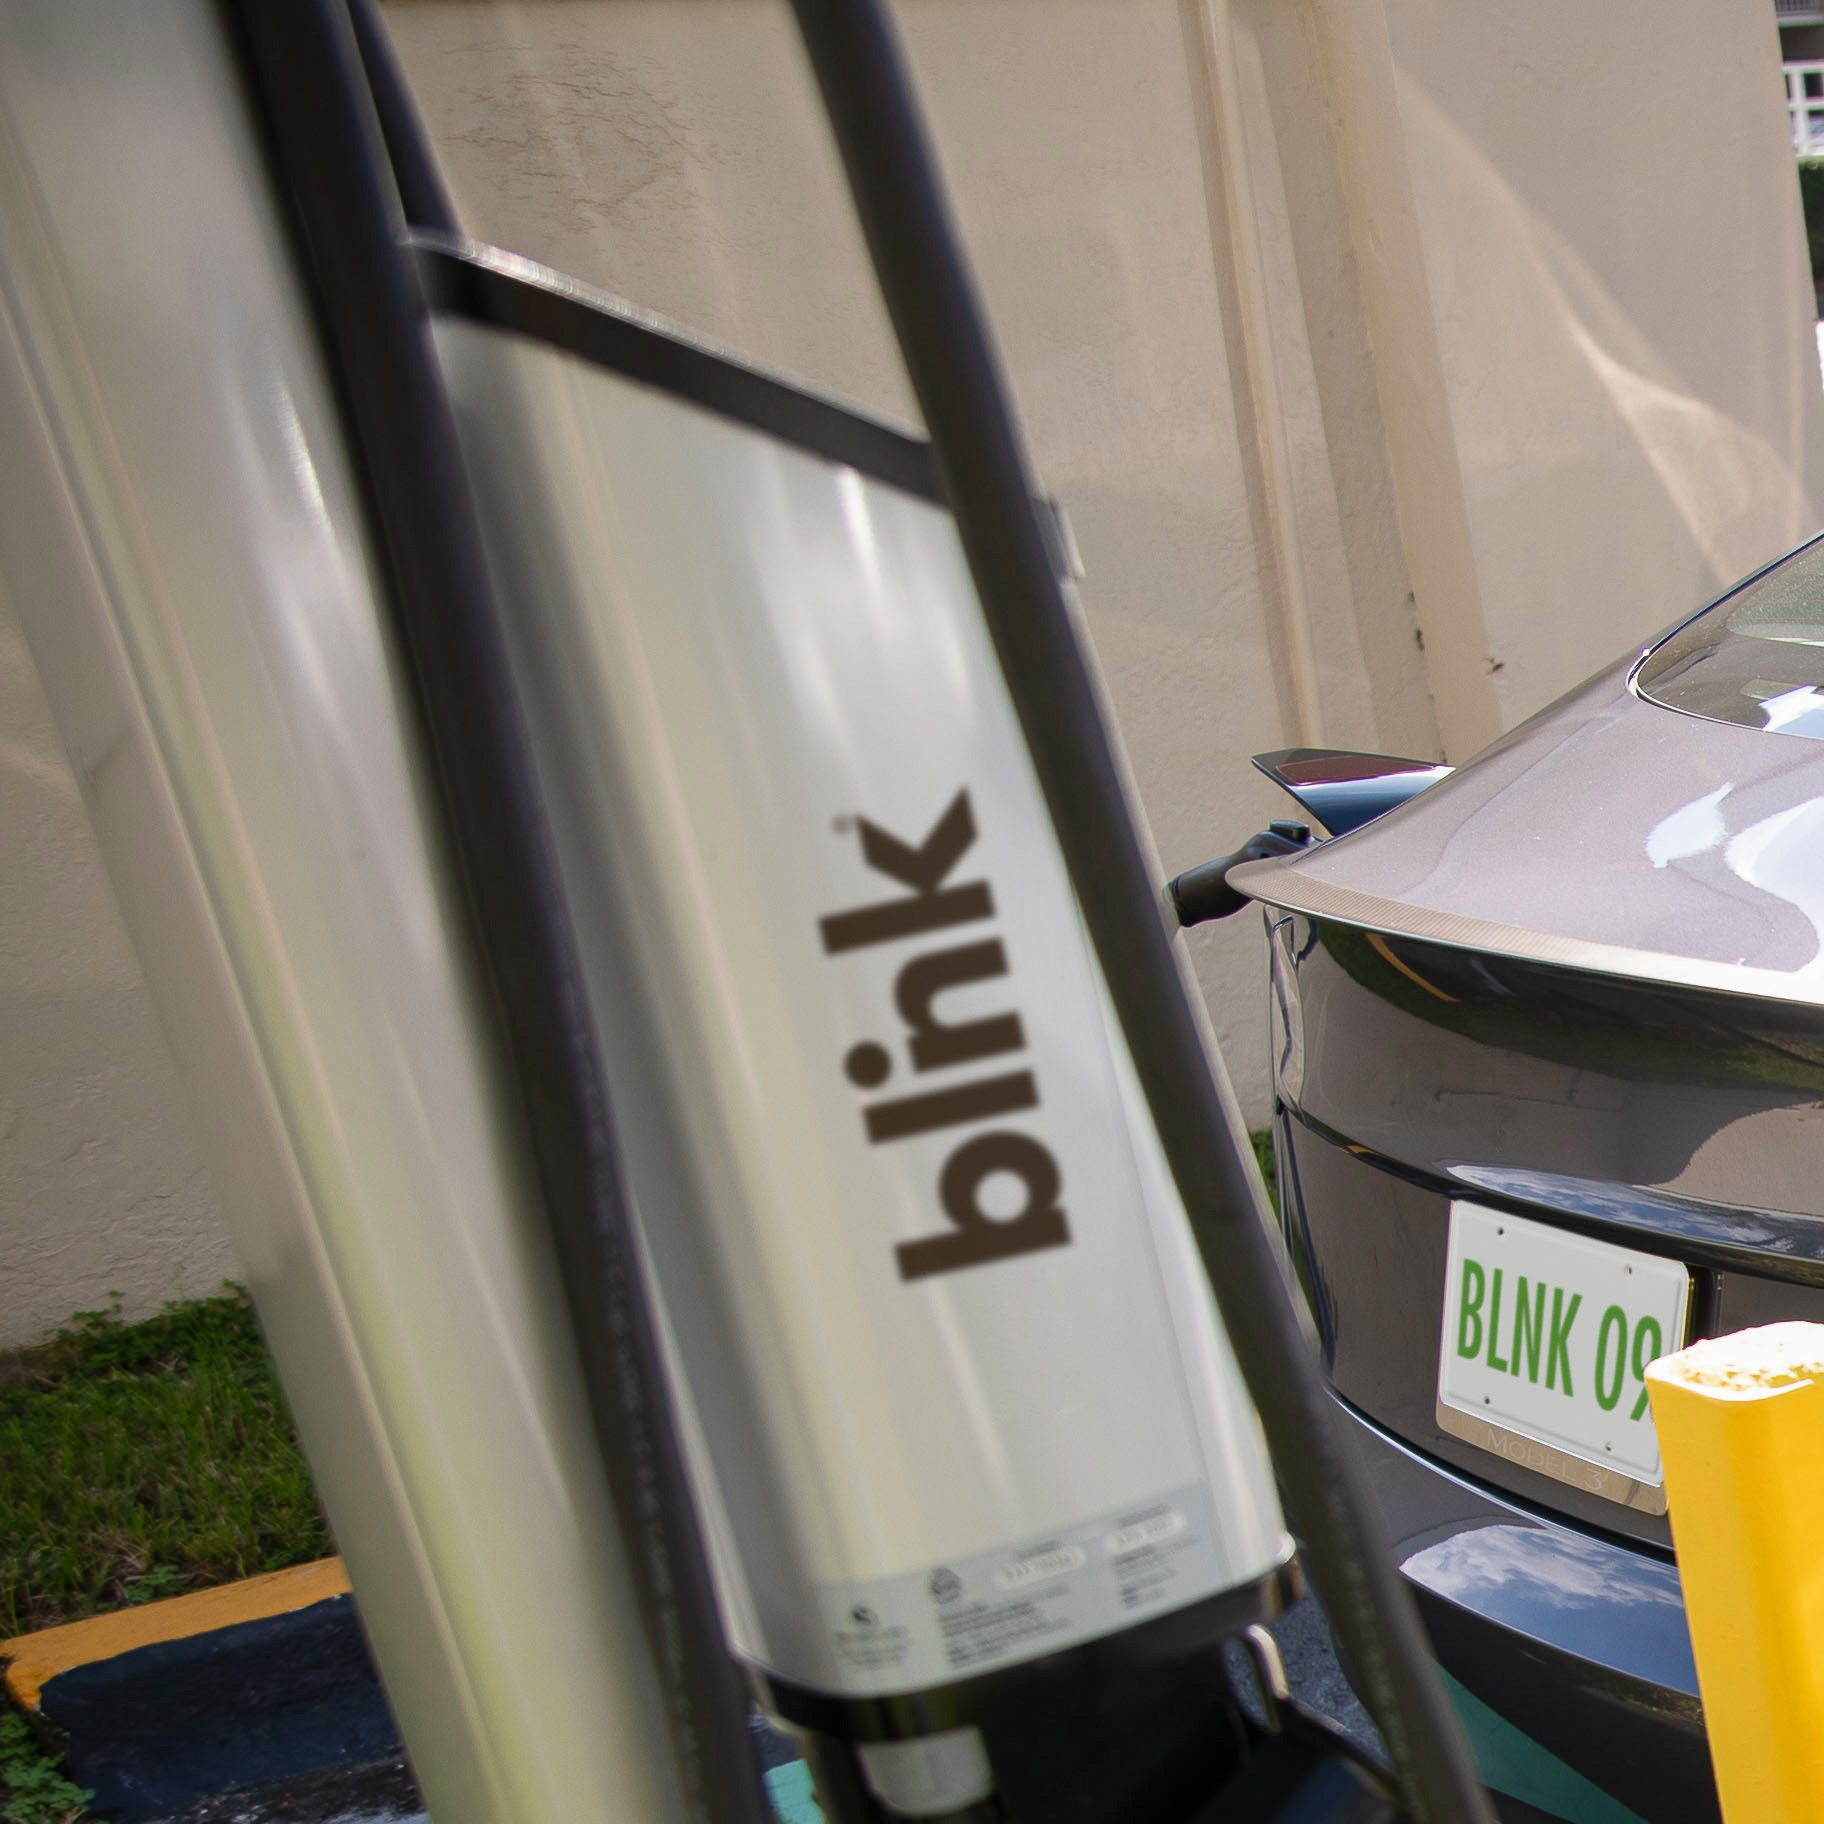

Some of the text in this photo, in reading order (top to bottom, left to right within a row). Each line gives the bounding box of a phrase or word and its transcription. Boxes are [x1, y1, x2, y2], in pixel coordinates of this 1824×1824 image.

[818, 785, 1072, 1283] blink
[1457, 1258, 1662, 1422] BLNK 09
[1486, 1428, 1604, 1491] MODEL 3
